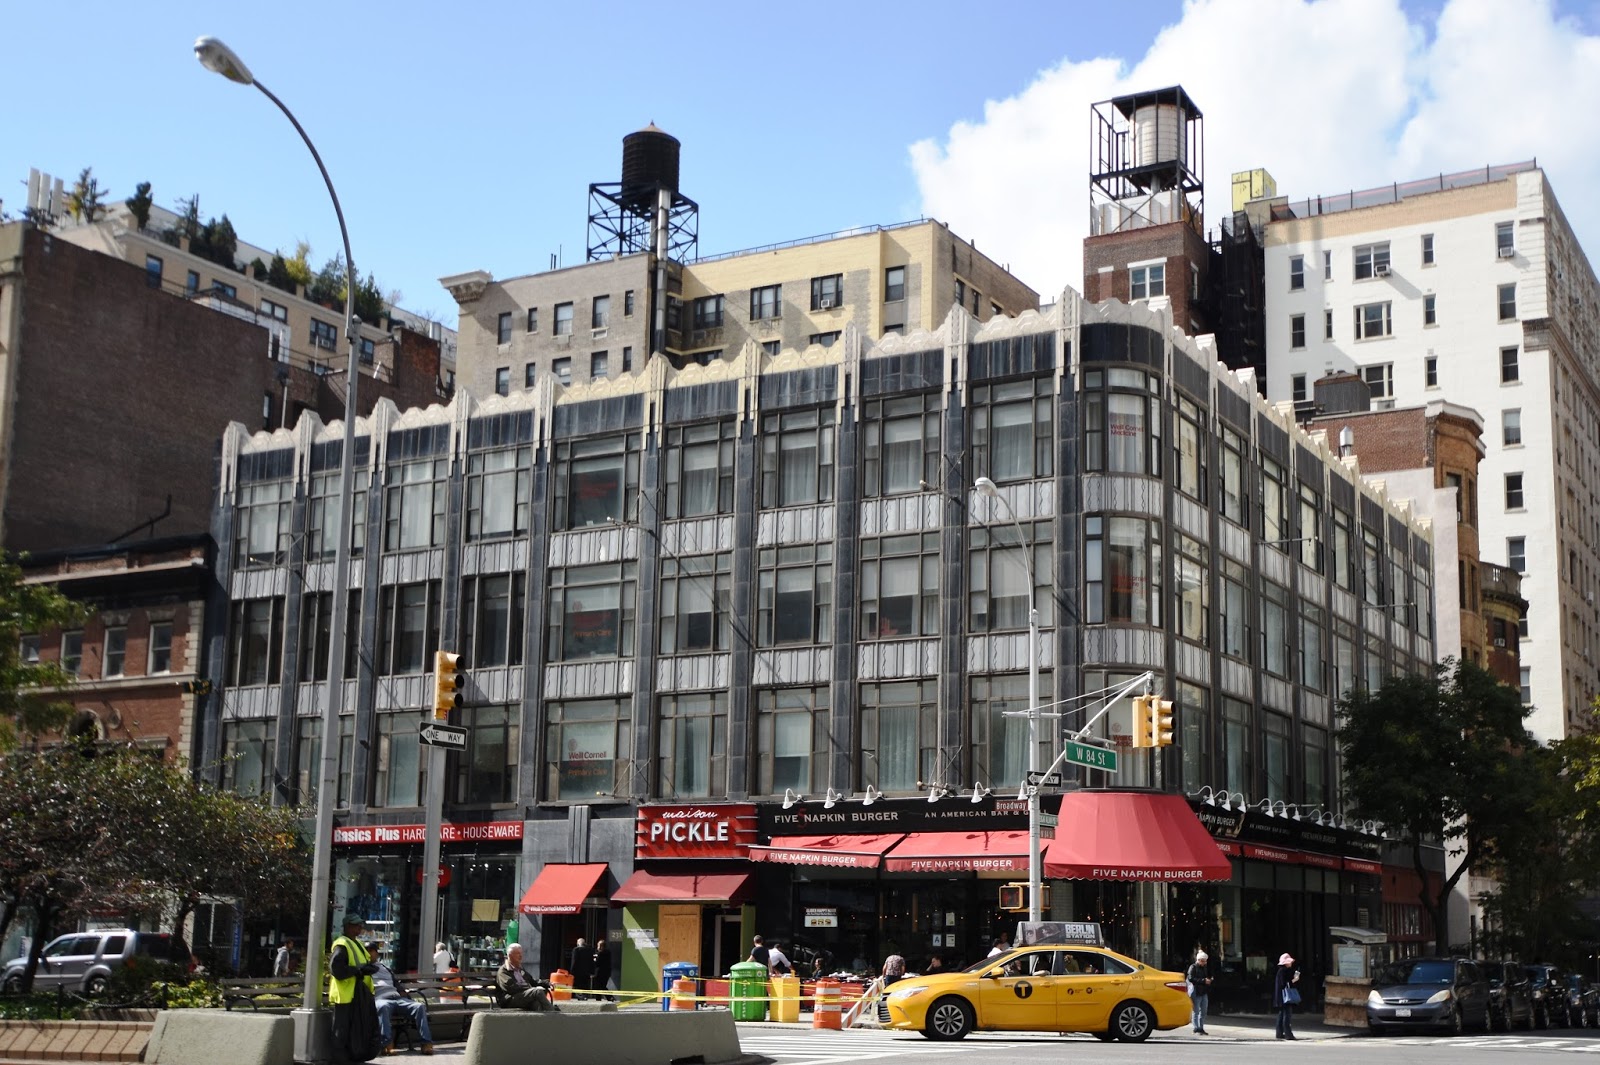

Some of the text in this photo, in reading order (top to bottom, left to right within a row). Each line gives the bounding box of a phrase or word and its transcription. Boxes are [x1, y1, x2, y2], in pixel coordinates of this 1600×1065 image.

[426, 729, 461, 743] ONE WAY
[584, 750, 607, 759] Cornell
[1076, 747, 1106, 766] W 84 St
[996, 801, 1027, 811] Broadway
[663, 808, 718, 819] maison
[774, 815, 799, 824] FIVE
[804, 813, 846, 823] NAPKIN
[852, 811, 899, 822] BURGER
[941, 810, 987, 818] AMERICAN
[1217, 816, 1236, 827] BURGER
[334, 829, 371, 843] Basics
[375, 828, 400, 841] Plus
[463, 825, 520, 838] HOUSEWARE
[651, 821, 729, 842] PICKLE
[770, 853, 856, 865] FIVE NAPKIN BURGER
[934, 860, 971, 868] NAPKIN
[973, 859, 1013, 868] BURGER
[1093, 868, 1203, 879] FIVE NAPKIN BURGER
[1065, 924, 1095, 934] BERLIN
[1017, 983, 1029, 997] T
